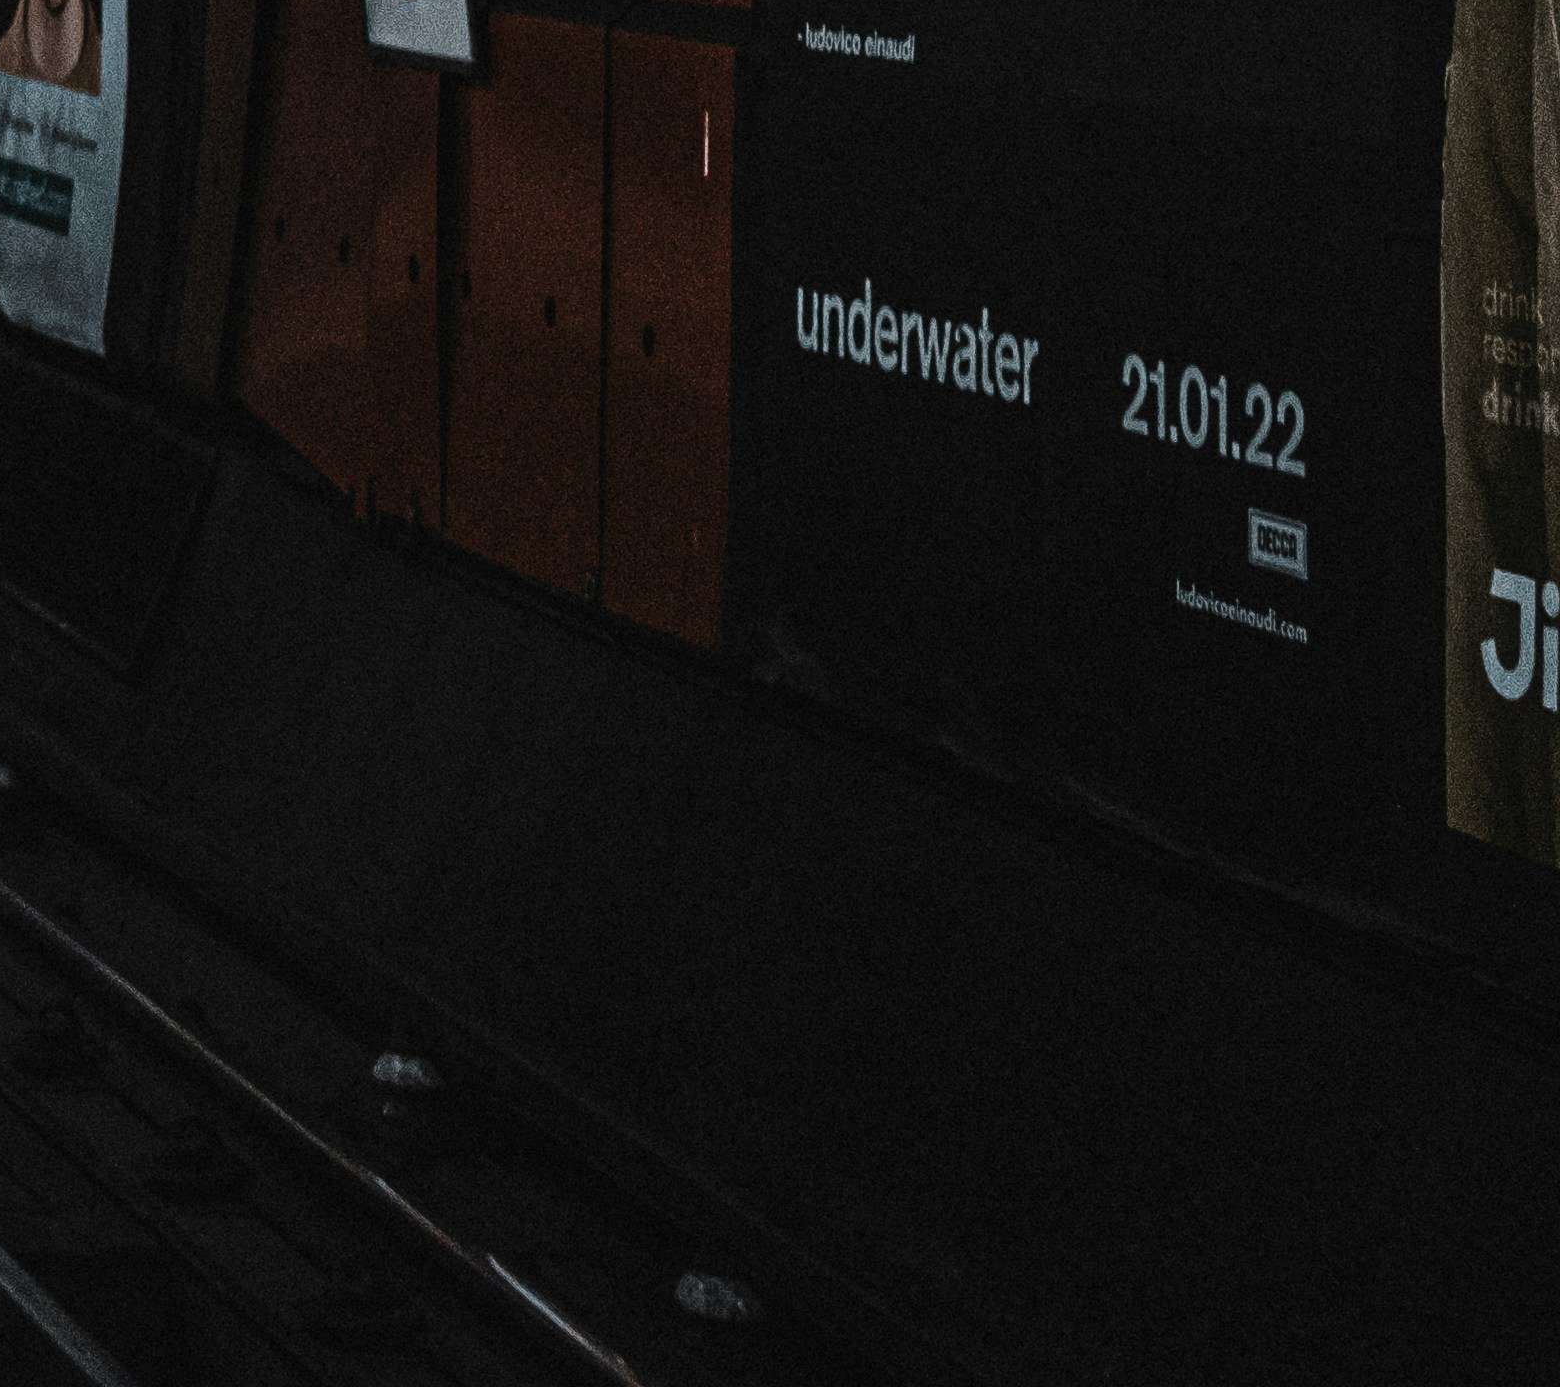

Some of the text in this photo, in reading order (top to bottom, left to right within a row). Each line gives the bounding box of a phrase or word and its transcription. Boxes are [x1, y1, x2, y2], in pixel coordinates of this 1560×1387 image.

[805, 22, 916, 62] ludovico einaudi
[796, 277, 1040, 405] underwater
[1121, 353, 1306, 478] 21.01.22
[1257, 524, 1298, 560] DECCA
[1176, 576, 1308, 644] ludovicoeinaudi.com
